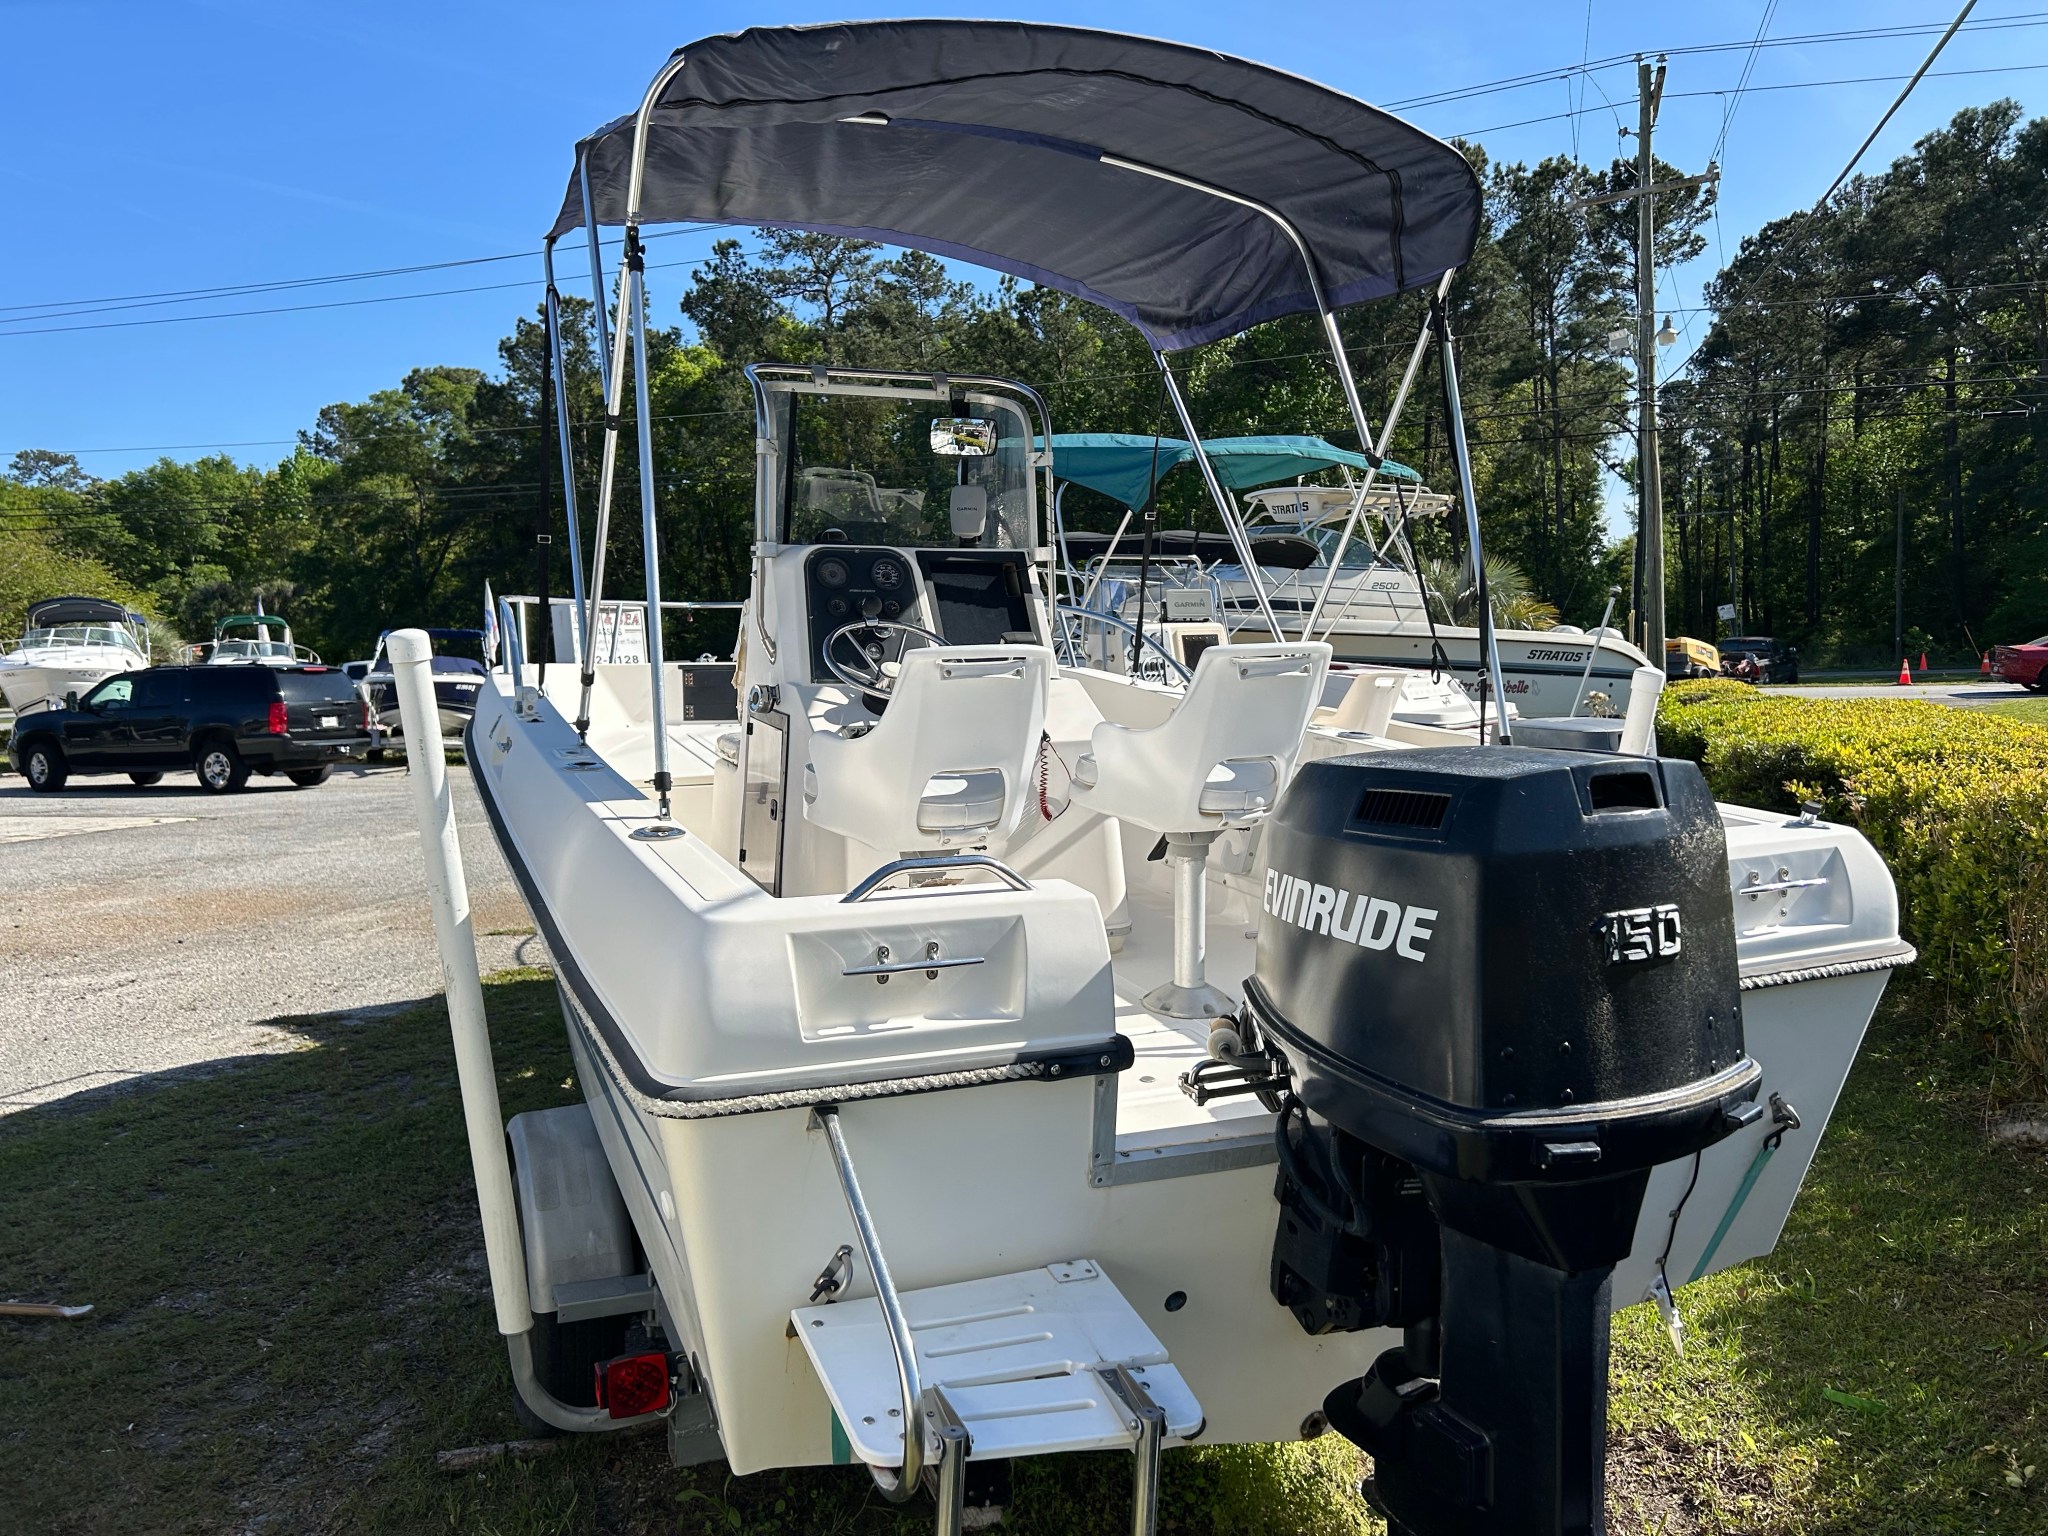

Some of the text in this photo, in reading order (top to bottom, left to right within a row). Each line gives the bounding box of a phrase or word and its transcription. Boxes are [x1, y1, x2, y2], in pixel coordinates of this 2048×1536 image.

[1371, 581, 1400, 590] 2500
[1526, 649, 1584, 662] STRATOS
[1263, 867, 1439, 963] EVINRUDE
[1600, 903, 1682, 962] 150
